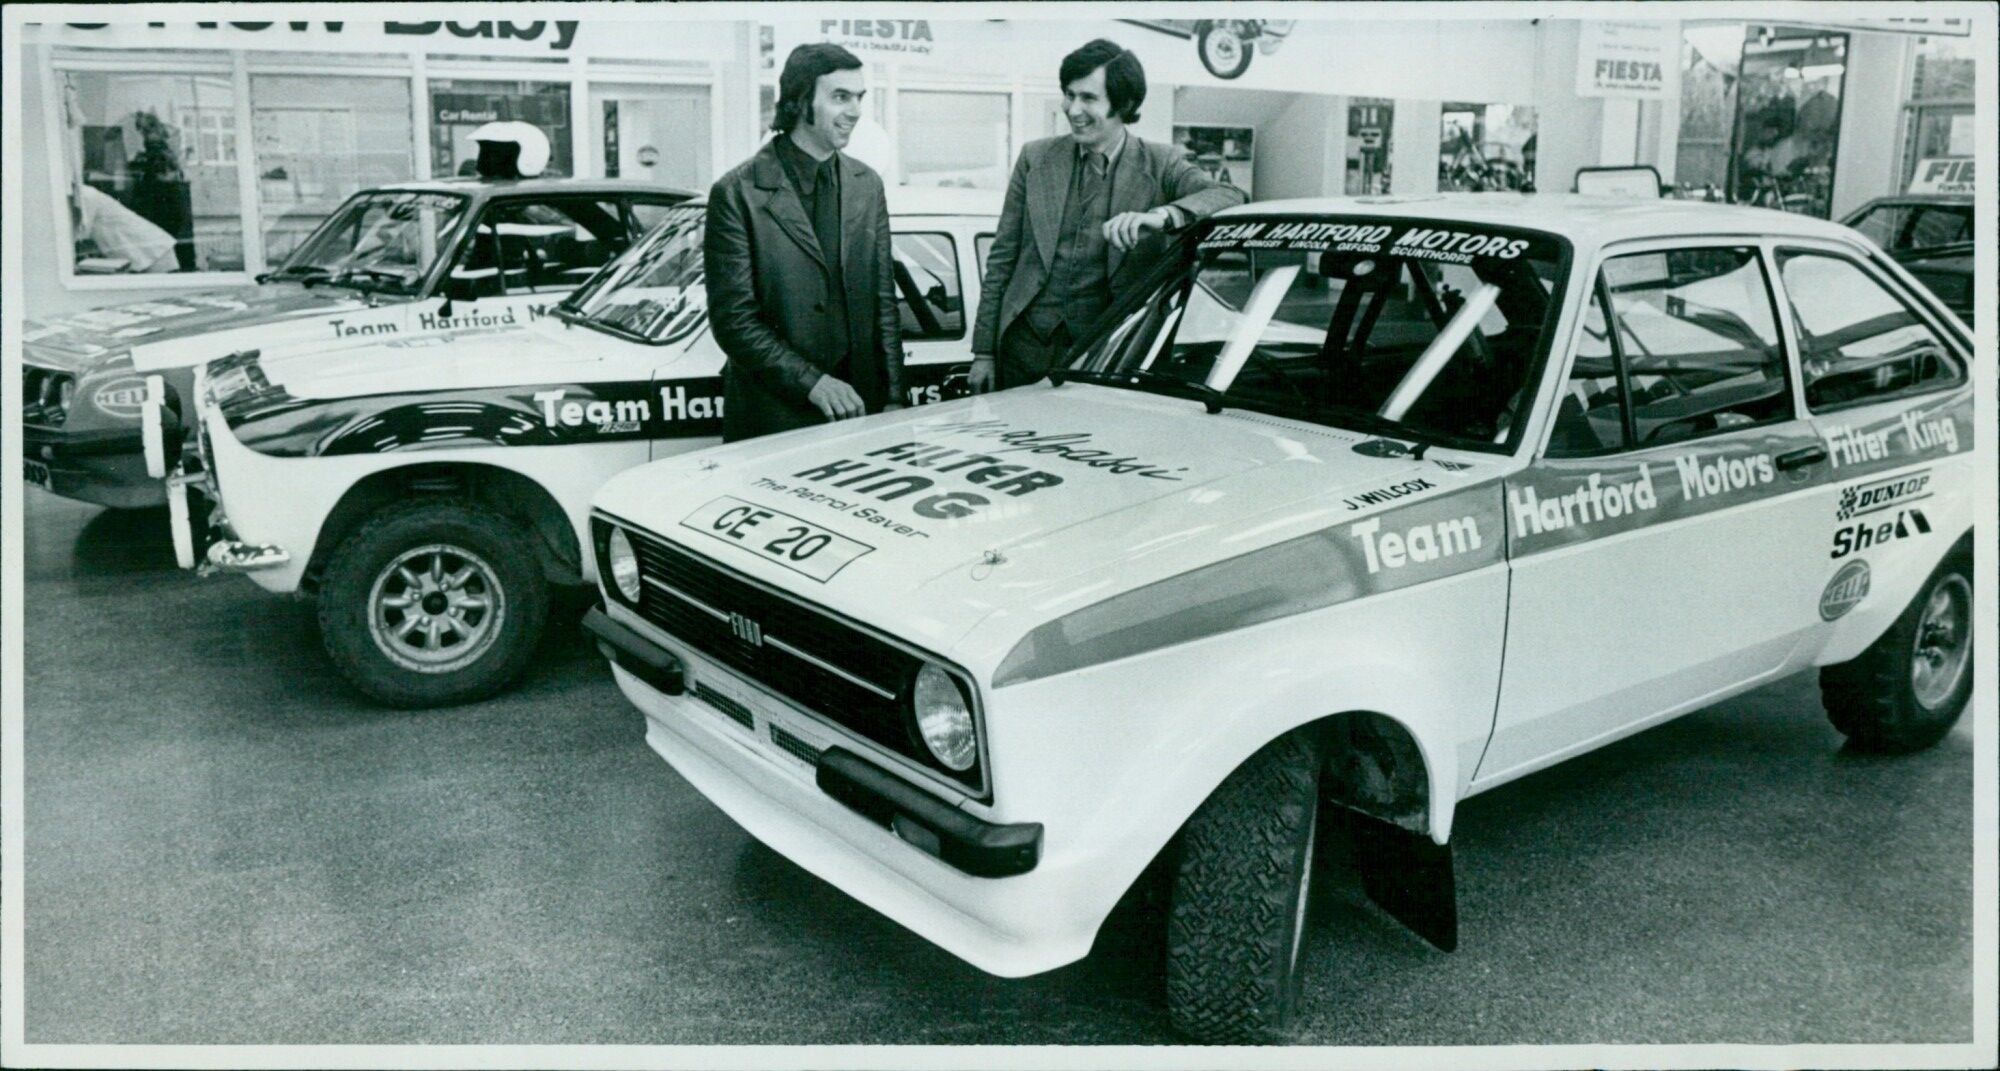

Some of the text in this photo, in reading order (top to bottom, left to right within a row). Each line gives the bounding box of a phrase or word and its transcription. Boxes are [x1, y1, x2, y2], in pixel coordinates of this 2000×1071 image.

[820, 19, 933, 41] FIESTA
[1595, 59, 1662, 82] FIESTA
[440, 109, 498, 121] Car Rental
[1205, 222, 1530, 259] TEAM HARTFORD MOTORS
[1288, 241, 1331, 250] LINCOLN
[1336, 242, 1382, 253] OXFORD
[1389, 246, 1475, 264] SCUNTHORPE
[329, 319, 399, 338] Team
[419, 307, 516, 331] Hartford
[534, 389, 650, 427] Team
[864, 442, 1065, 497] FILTER
[792, 459, 992, 520] KING
[1342, 478, 1437, 511] J.WILCOX
[1351, 409, 1959, 574] Team Hartford Motors Filter King
[1857, 475, 1931, 509] DUNLOP
[750, 477, 930, 539] The Petrol Saver
[713, 506, 832, 561] CE 20
[1824, 570, 1871, 604] HELLA
